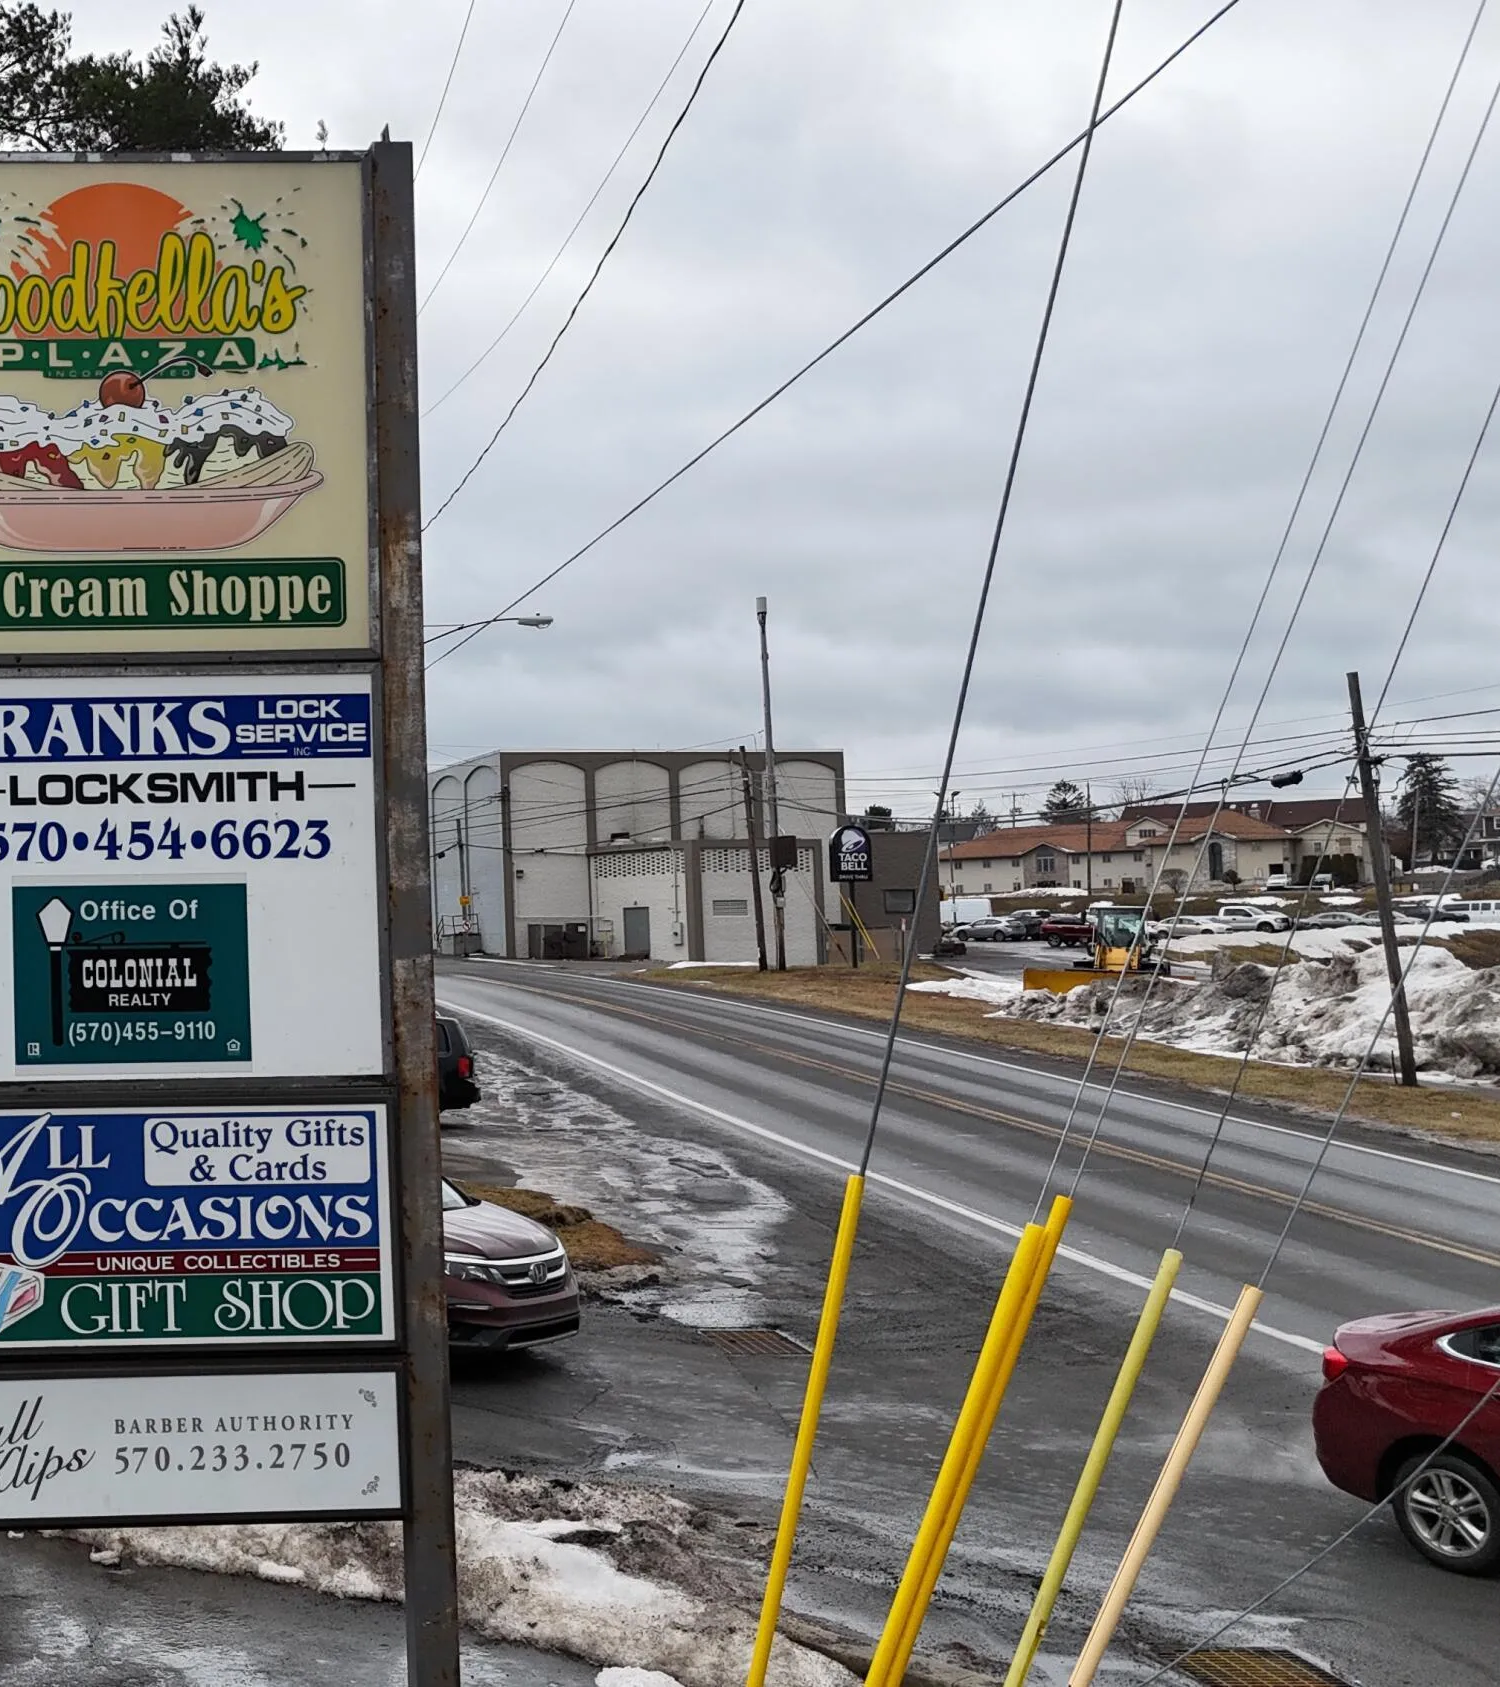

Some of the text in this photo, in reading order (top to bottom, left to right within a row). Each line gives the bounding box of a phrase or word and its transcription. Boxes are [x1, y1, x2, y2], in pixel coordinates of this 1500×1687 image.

[3, 570, 149, 619] Cream
[169, 569, 333, 621] Shoppe
[258, 699, 342, 719] LOCK
[235, 722, 367, 743] SERVICE
[9, 771, 305, 807] LOCKSMITH
[838, 852, 868, 862] TACO
[840, 861, 868, 871] BELL
[79, 899, 199, 922] Office Of
[82, 958, 198, 988] COLONIAL
[108, 993, 172, 1007] REALTY
[68, 1021, 216, 1046] (570)455-9110
[149, 1119, 365, 1155] Quality Gifts
[188, 1153, 328, 1182] & Cards
[11, 1172, 373, 1268] OCCASIONS
[96, 1253, 341, 1271] UNIQUE COLLECTIBLES
[60, 1277, 376, 1335] GIFT SHOP
[113, 1413, 355, 1435] BARBER AUTHORITY
[114, 1442, 352, 1474] 570.233.2750
